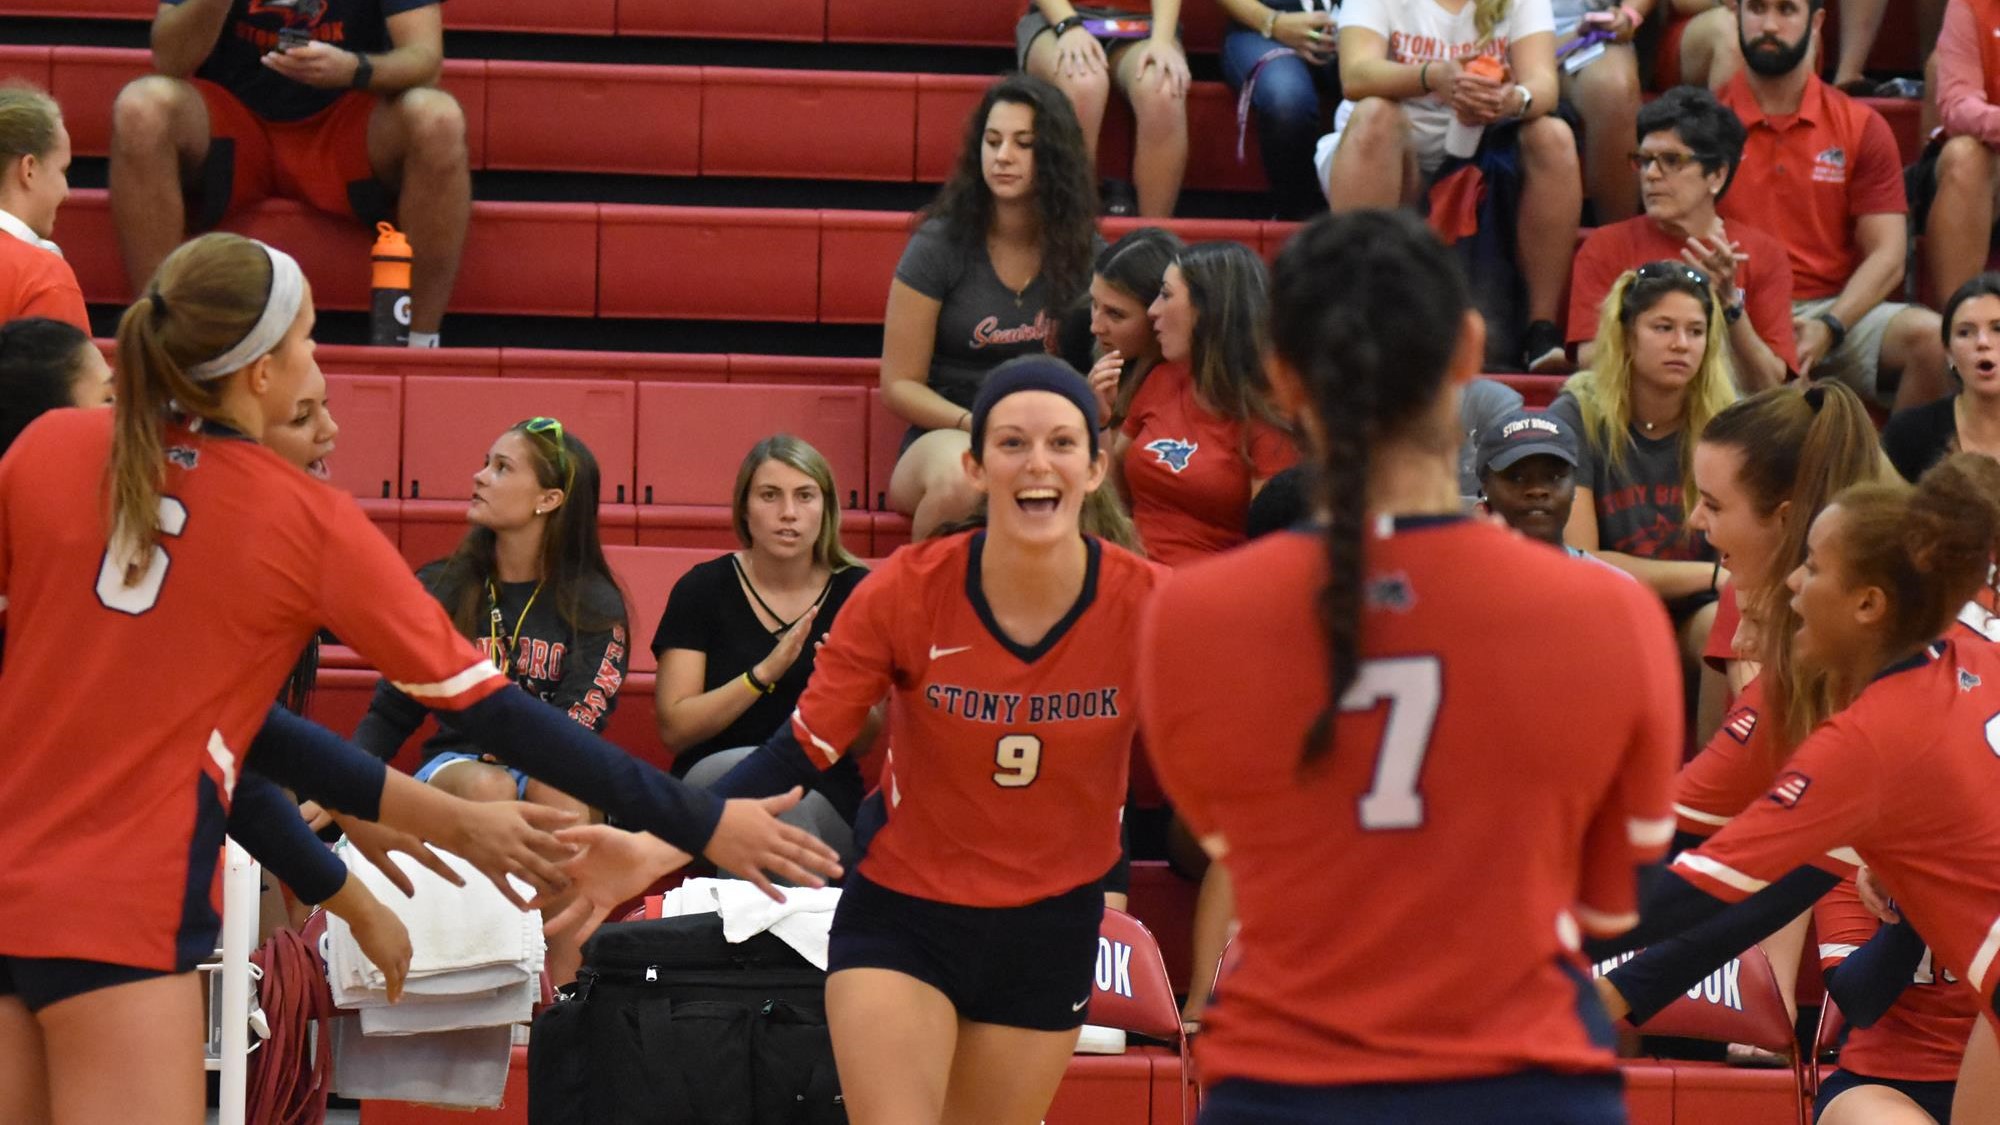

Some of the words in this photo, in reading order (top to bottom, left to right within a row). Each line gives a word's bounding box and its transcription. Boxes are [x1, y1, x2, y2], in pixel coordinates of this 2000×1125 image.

[1503, 418, 1530, 438] STONY
[925, 683, 1022, 725] STONY
[1028, 687, 1120, 724] BROOK
[992, 732, 1044, 789] 9
[1336, 653, 1445, 832] 7
